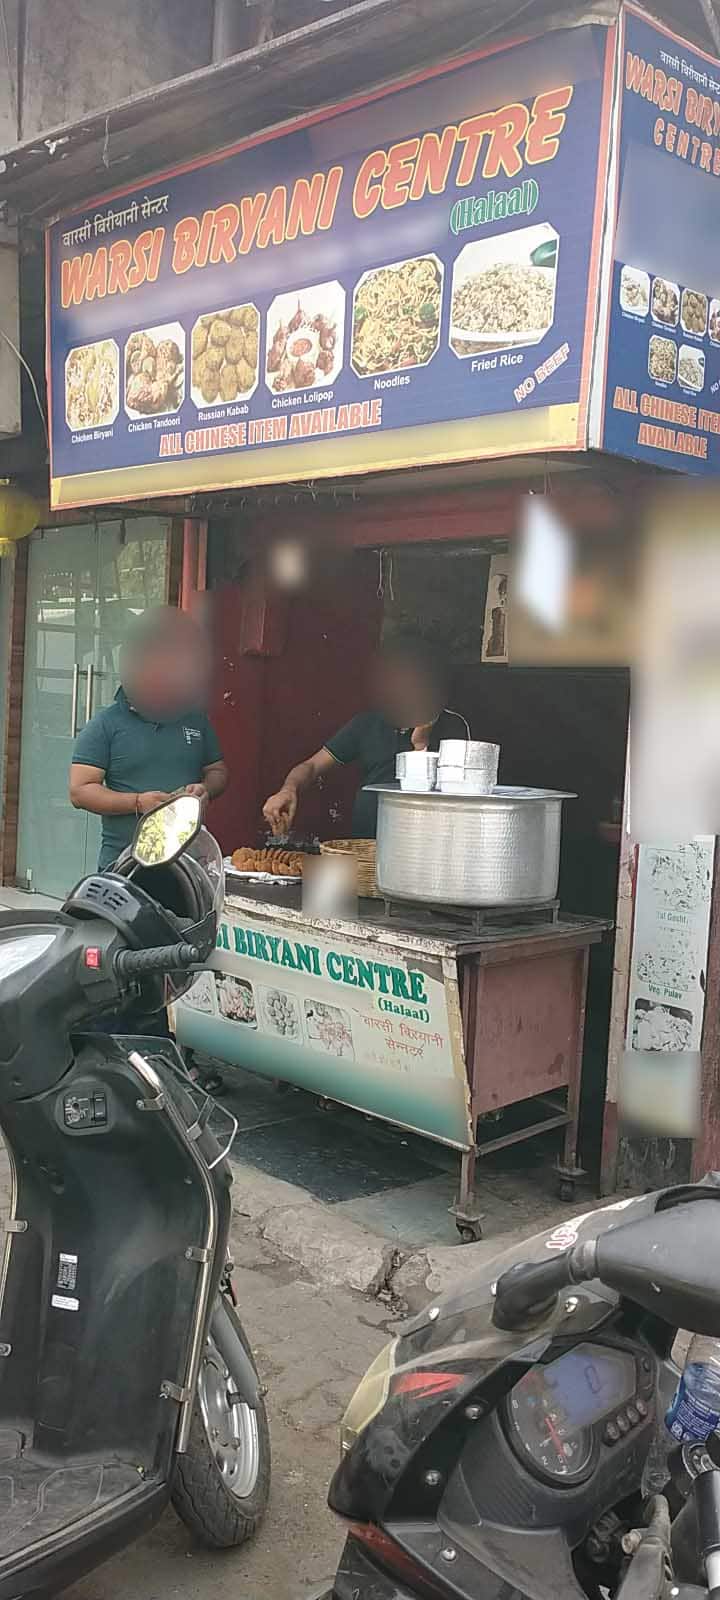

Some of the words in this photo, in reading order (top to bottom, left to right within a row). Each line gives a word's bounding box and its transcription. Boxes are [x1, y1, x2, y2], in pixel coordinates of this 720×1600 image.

[625, 51, 683, 116] WARSI
[653, 117, 720, 176] CENTRE
[61, 227, 165, 309] WARSI
[172, 165, 344, 274] BIRYANI
[353, 85, 573, 219] CENTRE
[448, 178, 539, 235] (Halaal)
[62, 219, 92, 247] वारसी
[141, 195, 169, 219] सेन्टर
[373, 375, 411, 390] Noodles
[471, 356, 497, 372] Fried
[499, 353, 524, 367] Rice
[513, 377, 536, 403] NO
[534, 342, 570, 384] BEEF
[198, 410, 226, 421] Russian
[226, 405, 249, 417] Kabab
[271, 396, 302, 409] Chicken
[303, 391, 334, 404] Lolipop
[613, 386, 638, 414] ALL
[639, 393, 697, 428] CHINESE
[71, 433, 93, 444] Chicken
[93, 429, 114, 442] Biryani
[128, 421, 152, 433] Chicken
[153, 416, 181, 429] Tandoori
[159, 432, 184, 457] ALL
[184, 423, 247, 454] CHINESE
[247, 415, 288, 445] ITEM
[288, 399, 383, 439] AVAILABLE
[637, 422, 708, 459] AVAILABLE
[232, 926, 322, 976] BIRYANI
[325, 950, 428, 1005] CENTRE
[378, 997, 430, 1023] (Halaal)
